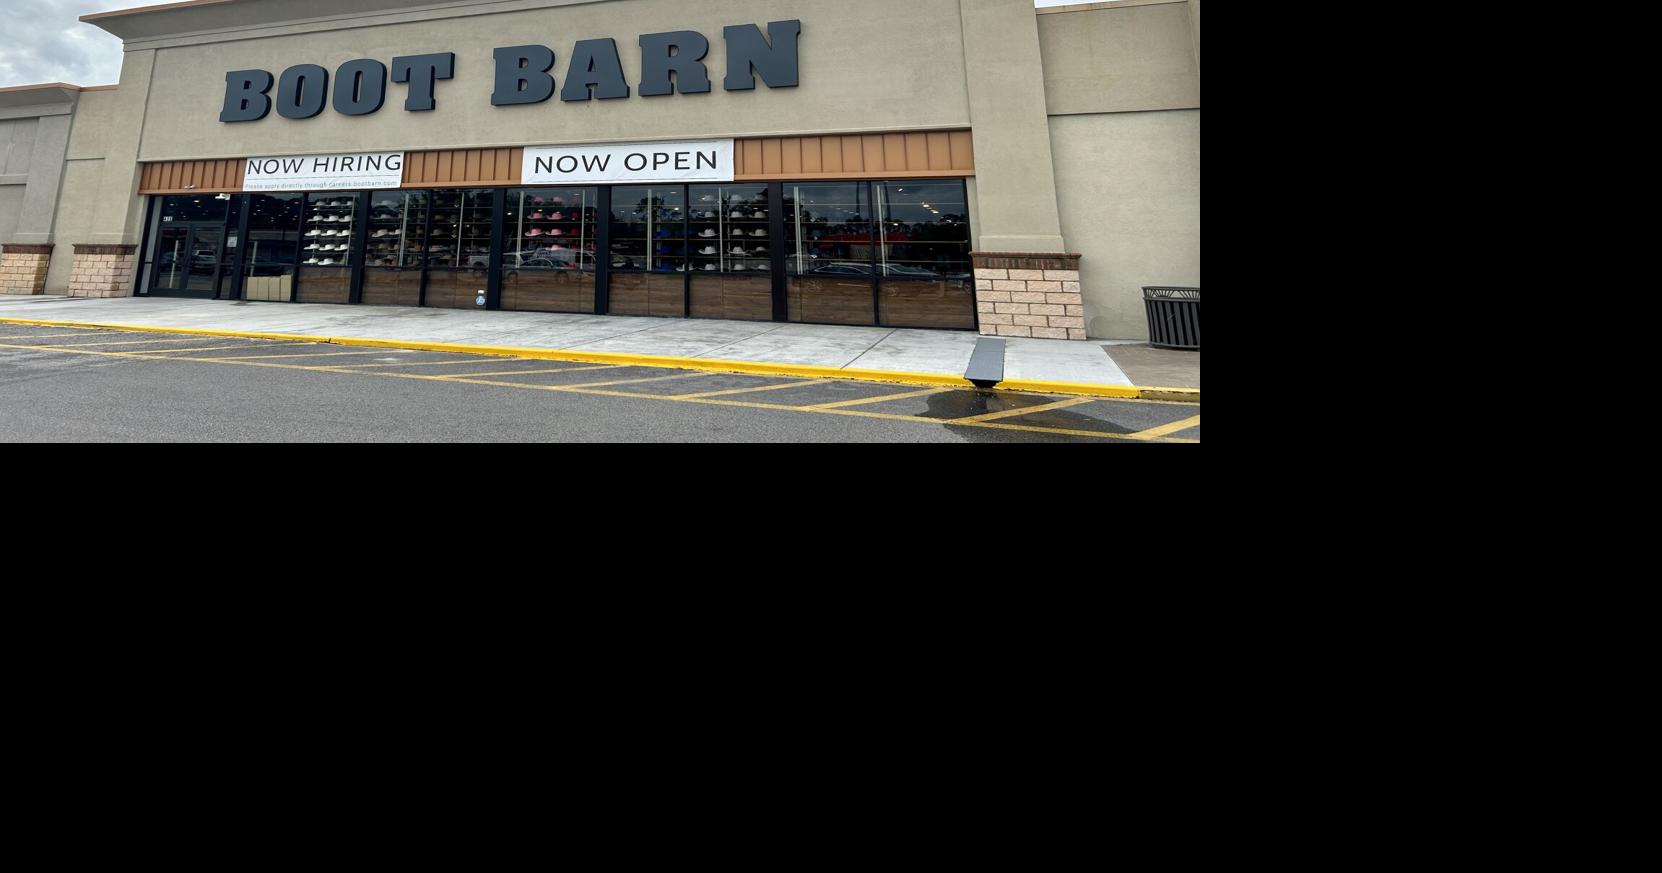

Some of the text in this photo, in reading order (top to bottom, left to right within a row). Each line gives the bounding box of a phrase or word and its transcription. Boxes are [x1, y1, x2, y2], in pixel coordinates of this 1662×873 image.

[219, 19, 801, 122] BOOT BARN
[247, 154, 401, 175] NOW HIRING
[534, 150, 717, 174] NOW OPEN
